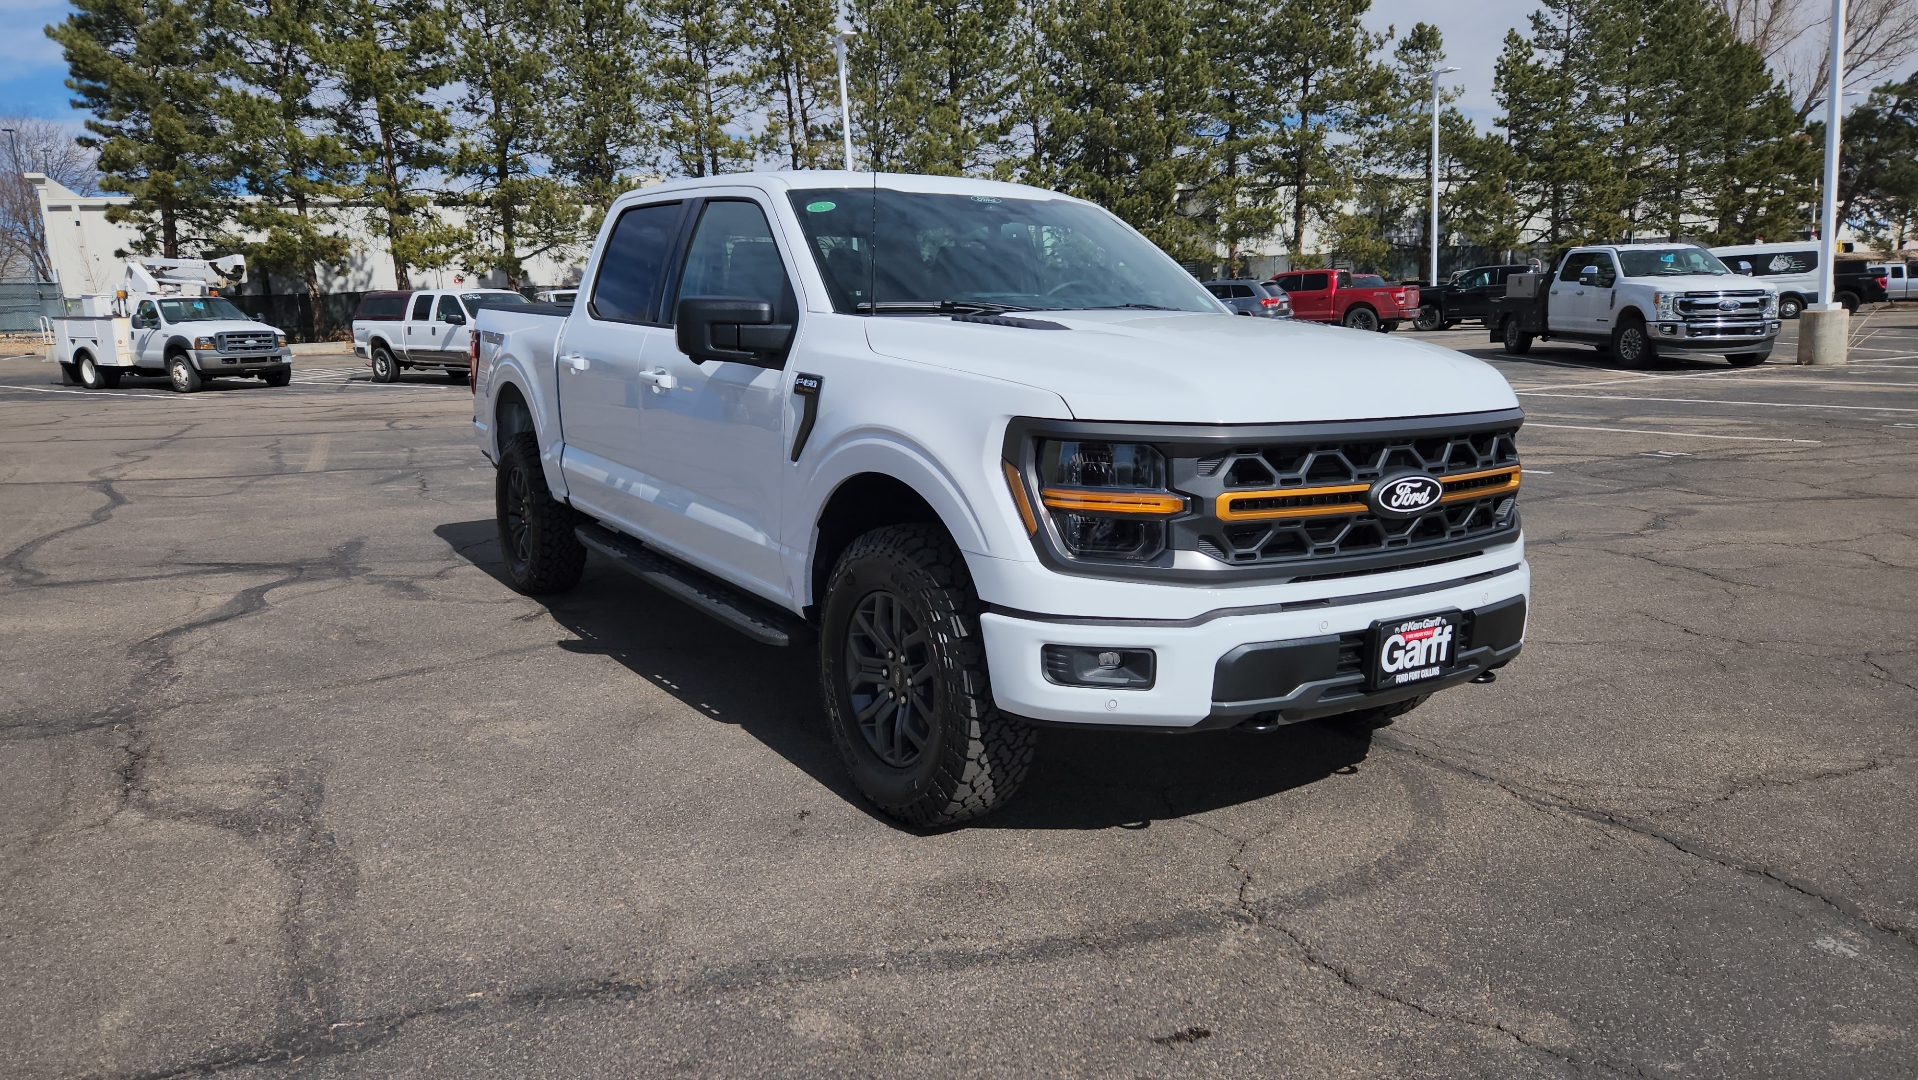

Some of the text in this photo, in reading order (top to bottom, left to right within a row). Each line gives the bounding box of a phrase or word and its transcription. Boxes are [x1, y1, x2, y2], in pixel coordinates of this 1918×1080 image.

[1391, 482, 1431, 507] Ford
[1407, 617, 1441, 631] Ken Garff
[1381, 625, 1452, 672] Garff
[1396, 672, 1408, 683] FORD
[1421, 667, 1440, 678] COLLINS
